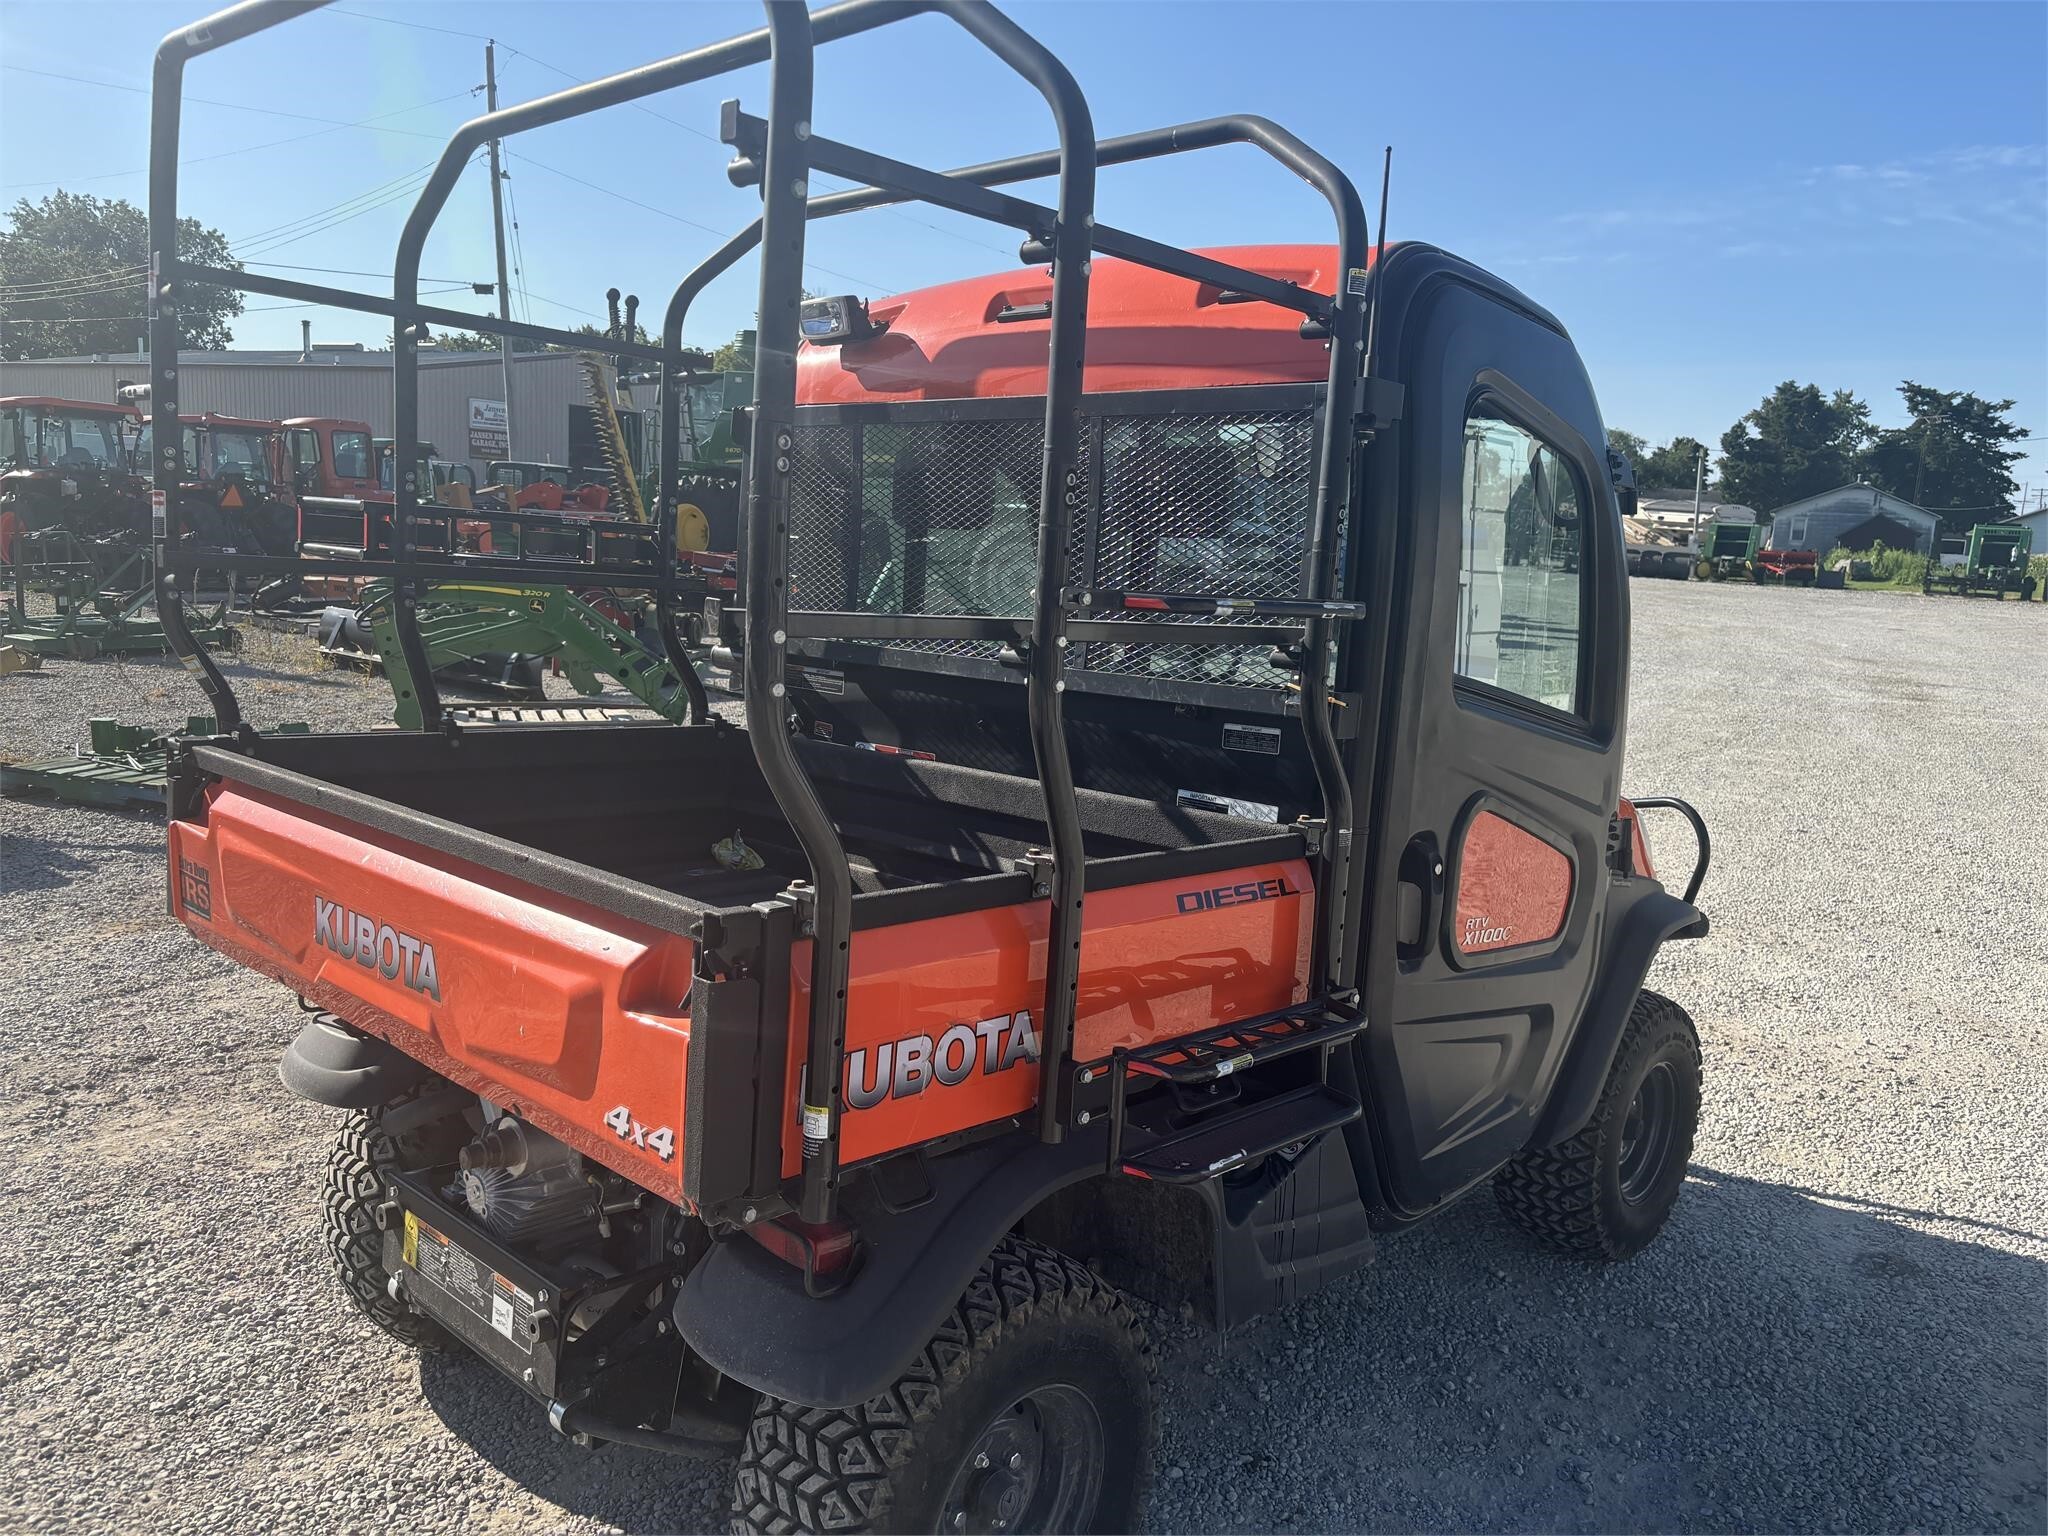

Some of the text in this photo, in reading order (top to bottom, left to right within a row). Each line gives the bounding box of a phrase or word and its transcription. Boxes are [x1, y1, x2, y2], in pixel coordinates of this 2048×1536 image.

[470, 431, 493, 440] JANSEN
[522, 589, 542, 597] 320
[1189, 792, 1218, 803] IMPORTANT
[1176, 878, 1300, 914] DIESEL
[1465, 916, 1490, 929] RTV
[1461, 926, 1513, 946] X1100C
[314, 894, 442, 1004] KUBOTA
[603, 1104, 675, 1164] 4x4
